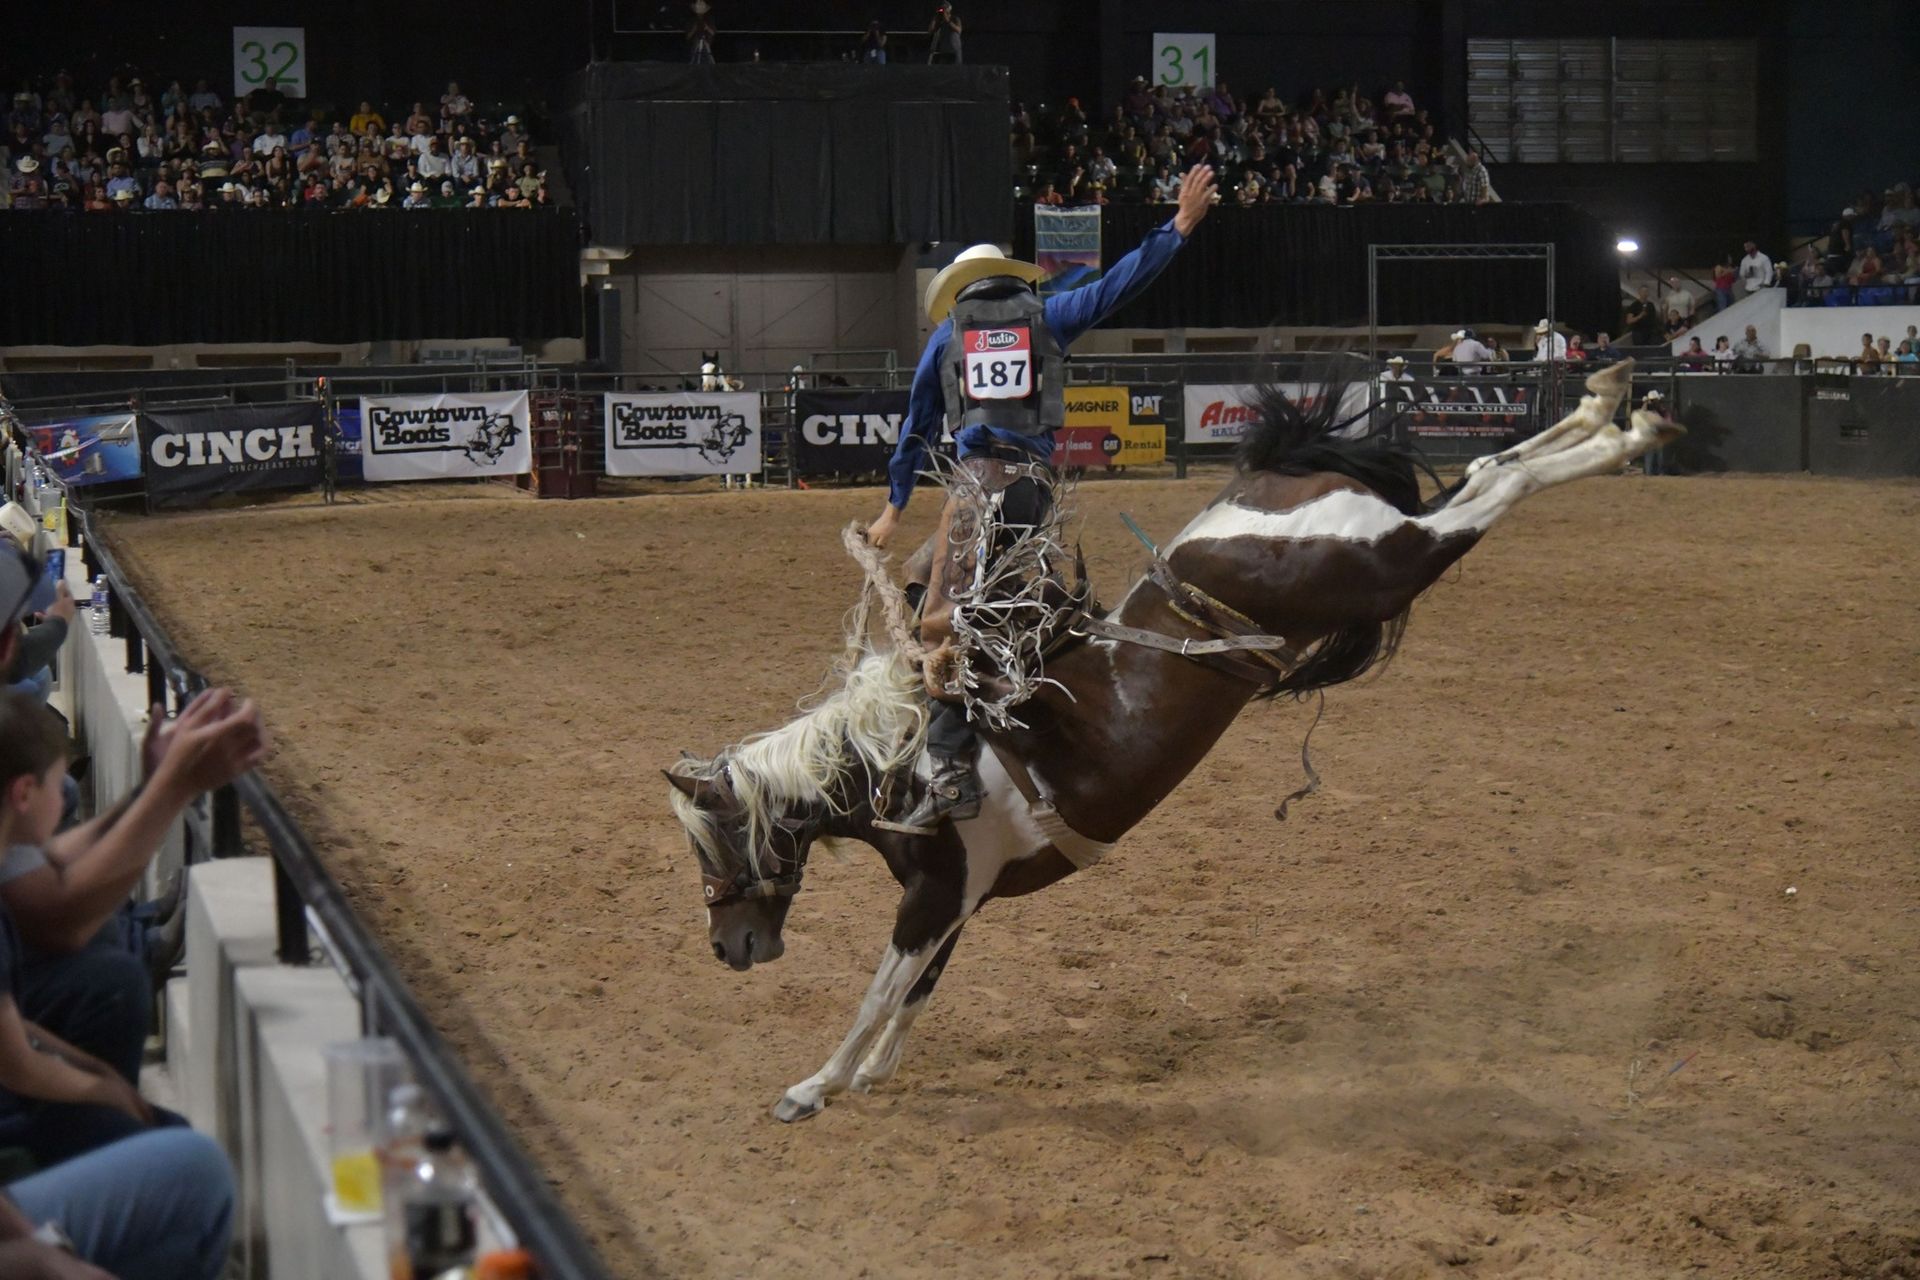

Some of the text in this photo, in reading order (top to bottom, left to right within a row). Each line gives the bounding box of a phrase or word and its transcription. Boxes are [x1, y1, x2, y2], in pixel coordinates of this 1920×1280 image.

[241, 41, 299, 83] 32
[1161, 46, 1208, 88] 31
[975, 330, 1016, 351] Justin
[972, 360, 1027, 388] 187
[617, 404, 721, 421] Cowtown
[1065, 401, 1119, 412] WAGNER
[1132, 395, 1163, 415] CAT
[374, 406, 487, 426] Cowtown
[380, 425, 450, 445] Boots
[622, 421, 687, 440] Boots
[802, 414, 956, 445] CIN
[151, 425, 316, 467] CINCH
[1104, 440, 1118, 450] CAT
[1124, 439, 1161, 449] Rental
